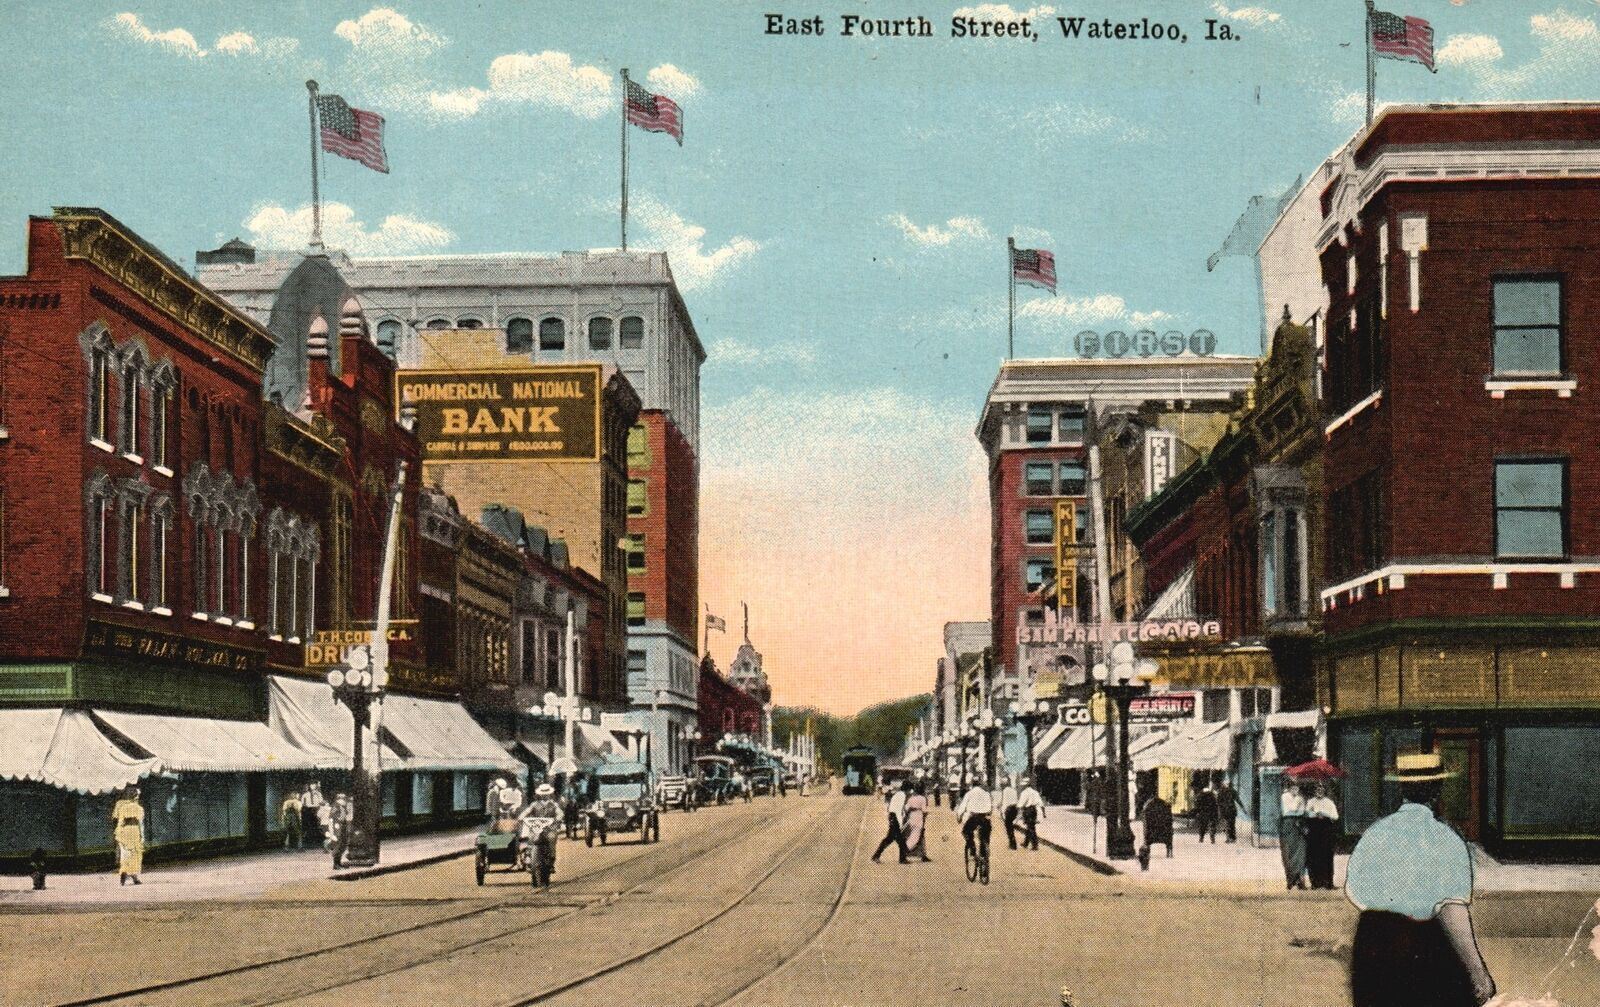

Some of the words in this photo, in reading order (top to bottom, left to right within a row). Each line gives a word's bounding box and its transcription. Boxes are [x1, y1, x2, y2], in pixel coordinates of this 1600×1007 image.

[1074, 329, 1217, 358] FIRST
[403, 382, 502, 401] COMMERCIAL
[512, 380, 585, 399] NATIONAL
[441, 405, 561, 434] BANK
[1143, 621, 1219, 639] CAFE
